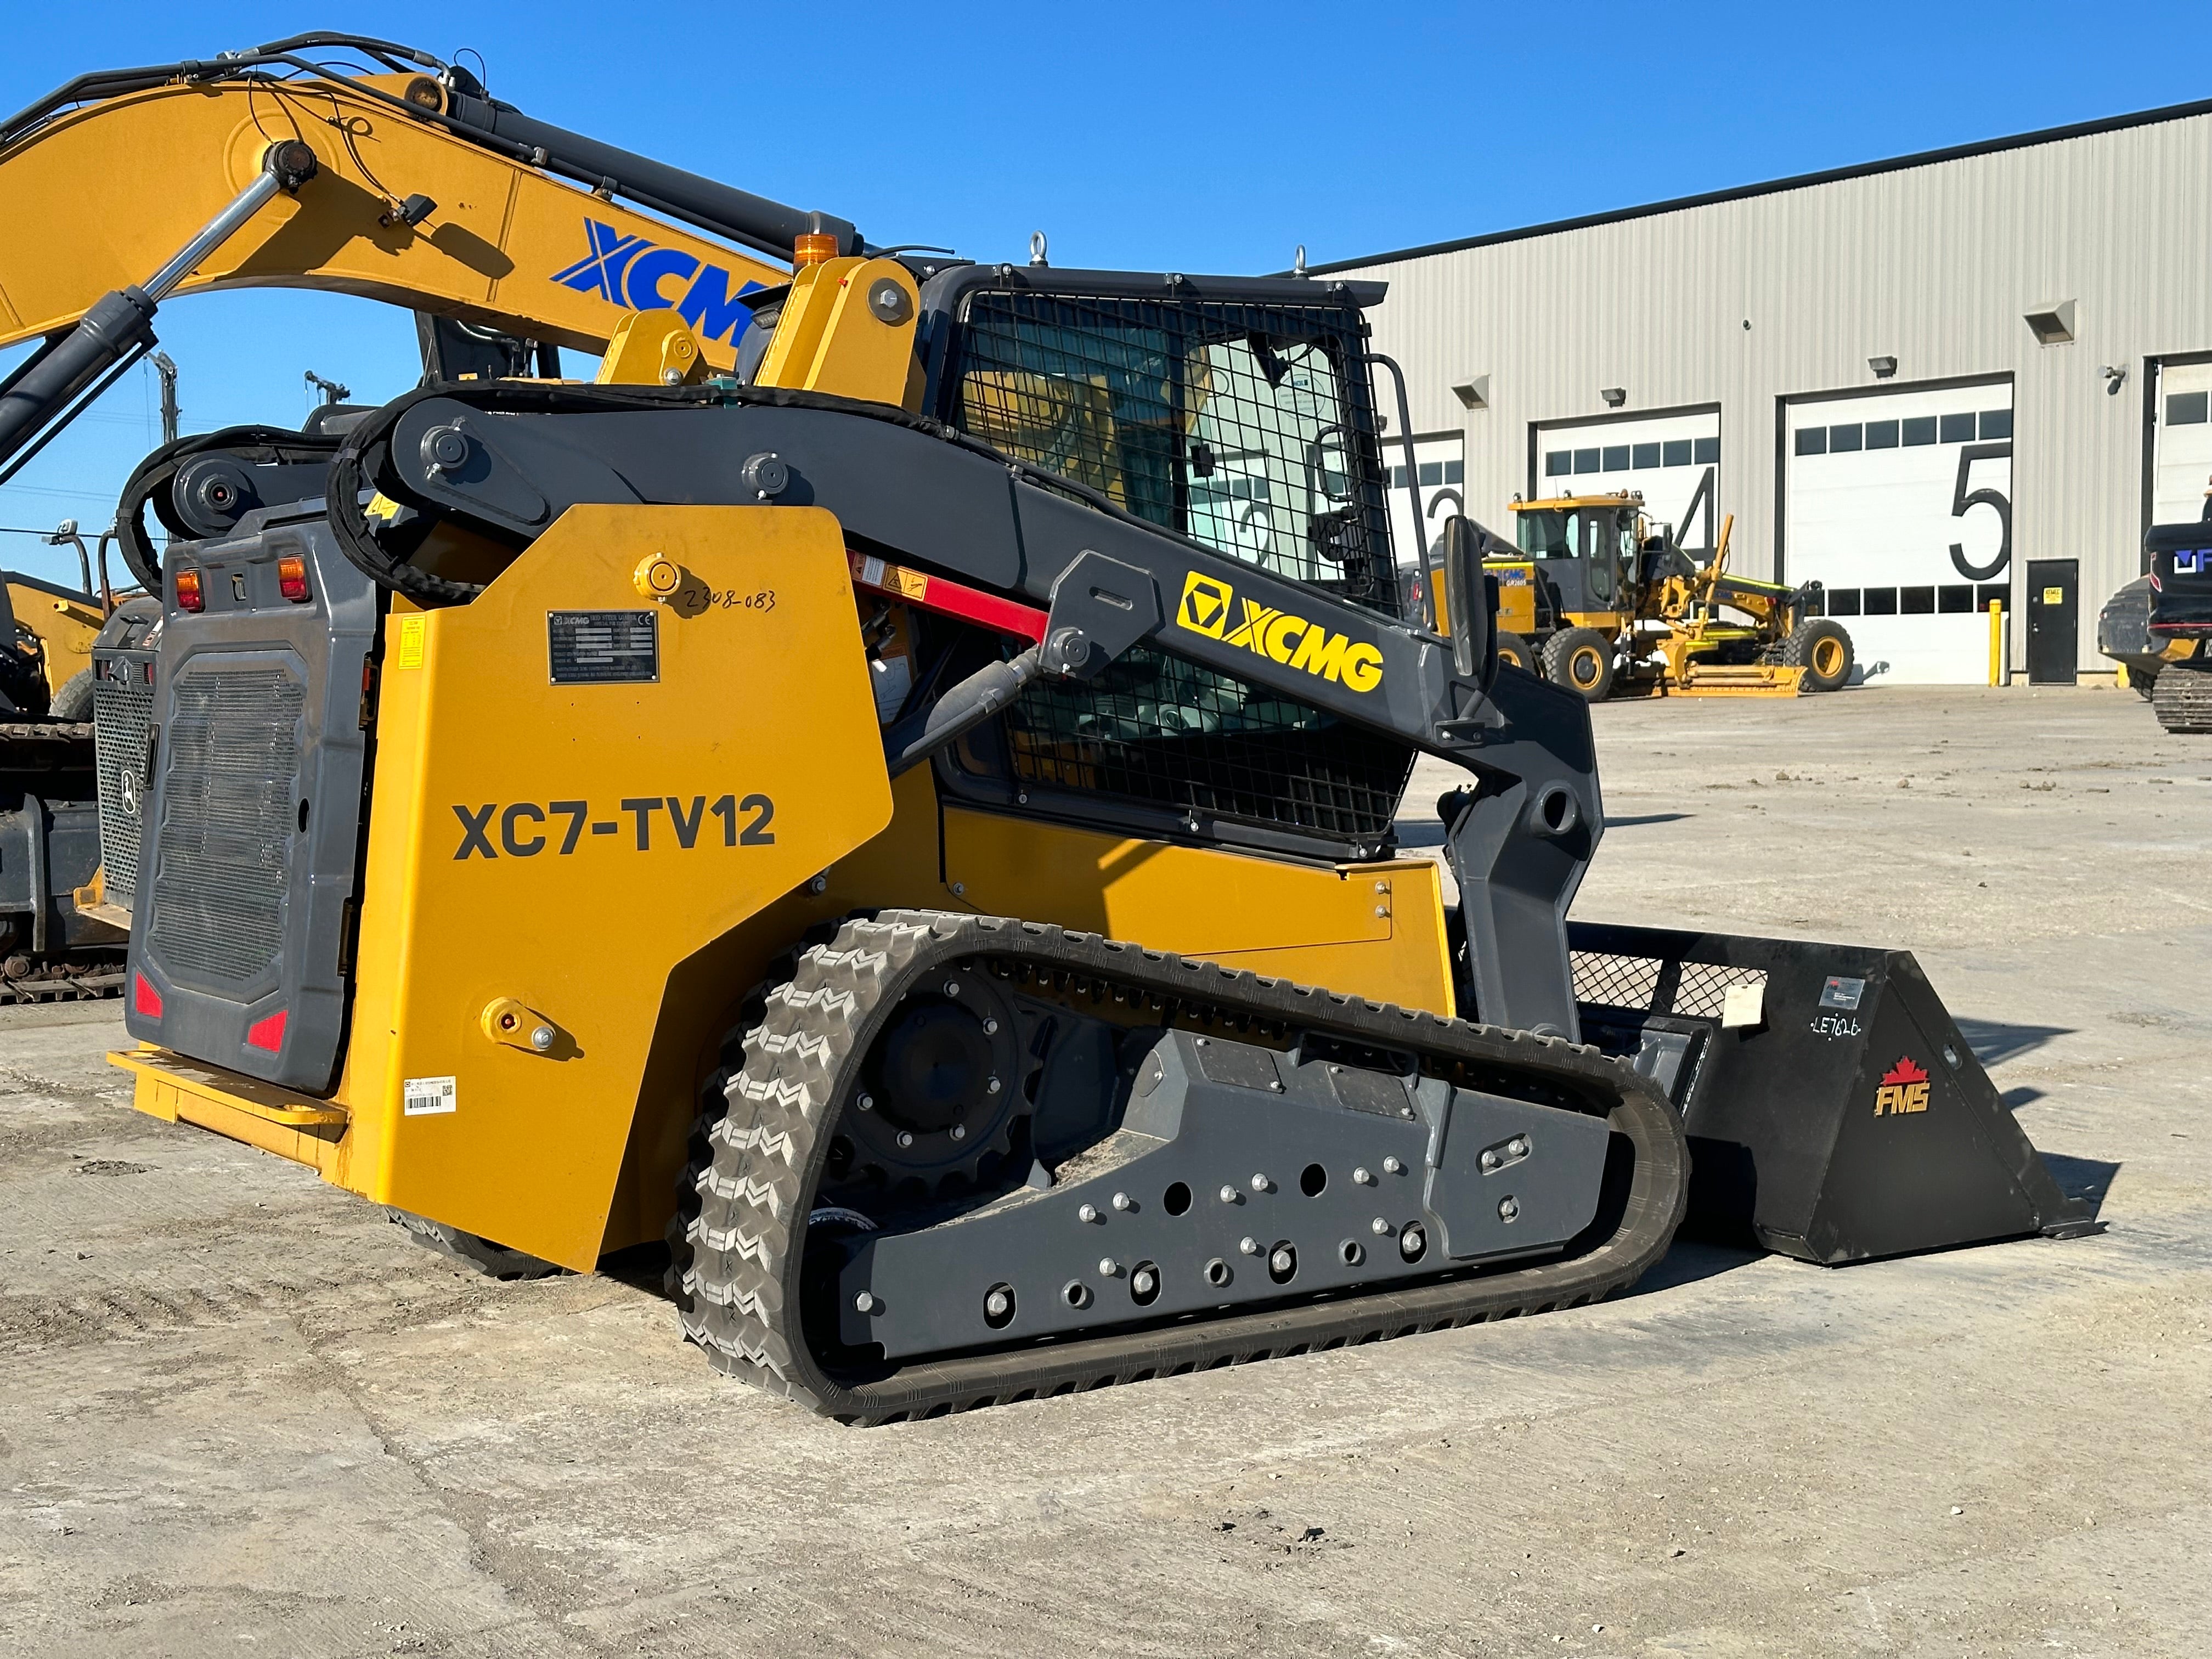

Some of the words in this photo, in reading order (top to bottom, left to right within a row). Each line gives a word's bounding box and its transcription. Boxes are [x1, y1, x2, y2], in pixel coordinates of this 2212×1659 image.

[549, 217, 769, 348] XCM
[1674, 467, 1718, 571] 4
[1949, 442, 2011, 581] 5
[563, 617, 590, 625] XCMG
[637, 614, 651, 625] CE
[684, 586, 776, 613] 2308-083
[1221, 597, 1384, 693] XCMG
[452, 793, 775, 860] XC7-TV12
[1874, 1082, 1930, 1117] FMS
